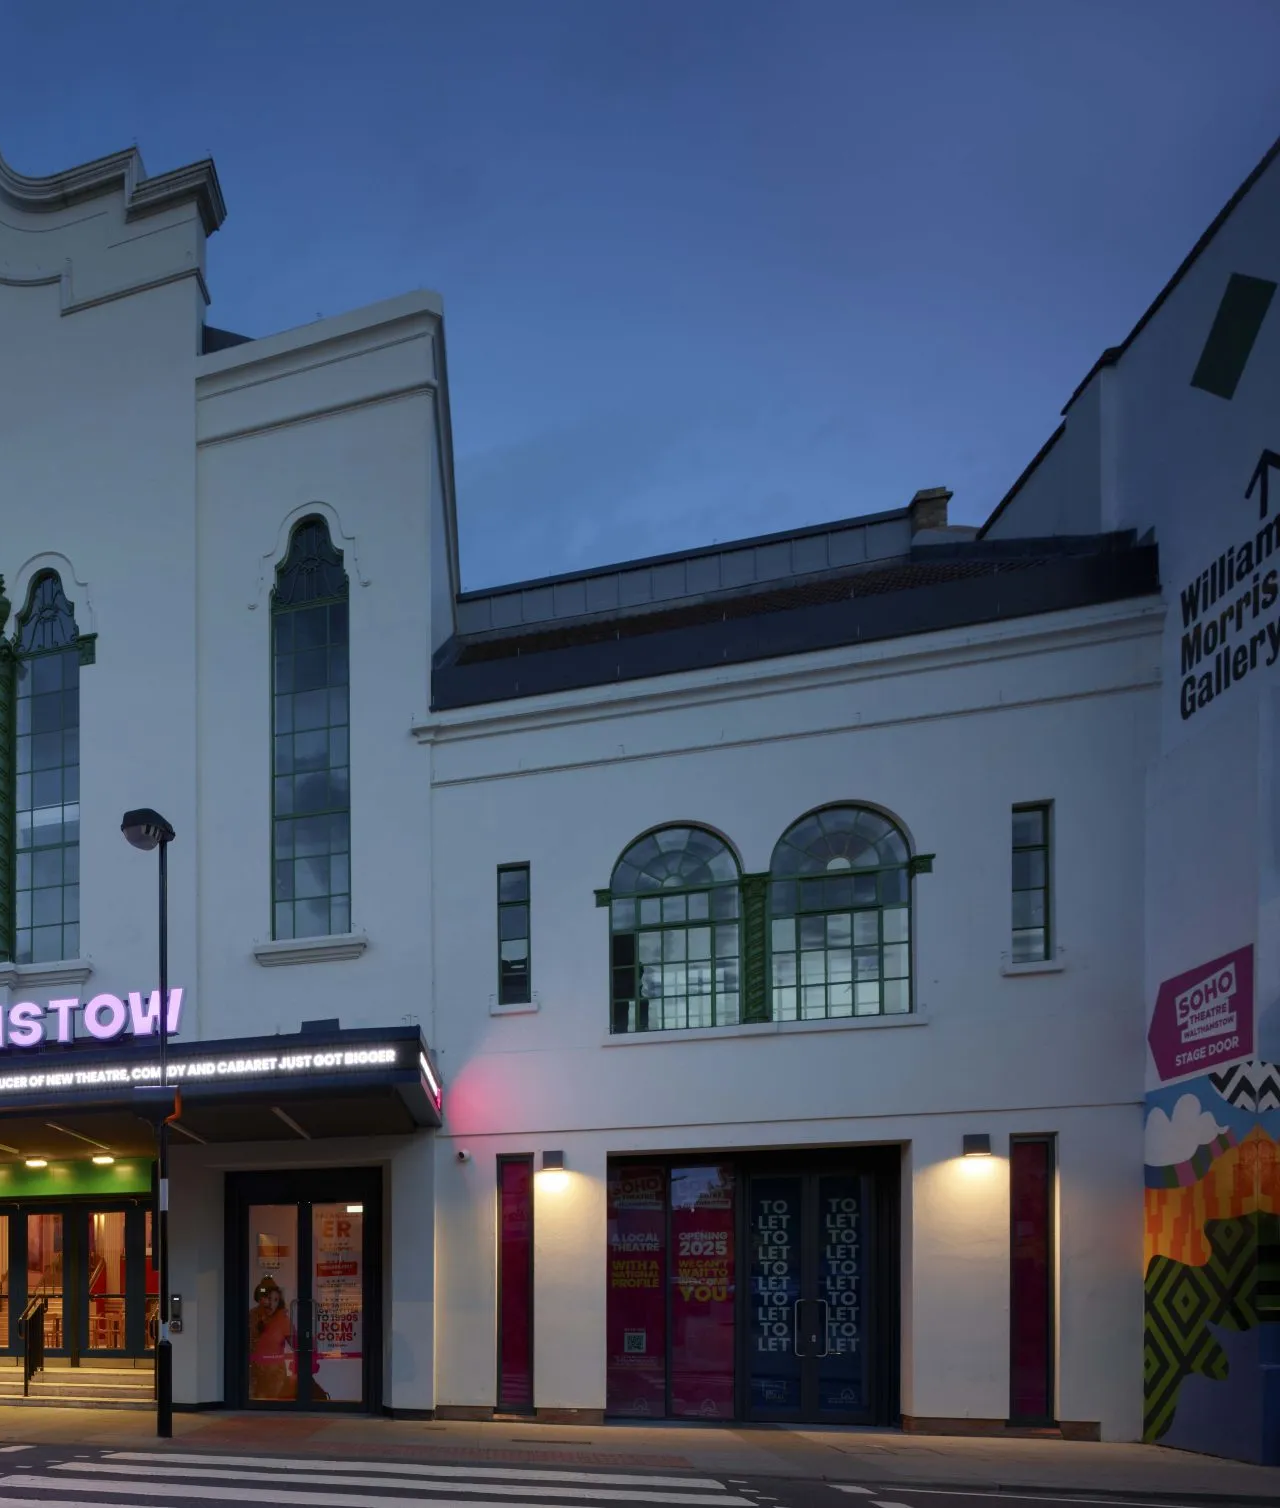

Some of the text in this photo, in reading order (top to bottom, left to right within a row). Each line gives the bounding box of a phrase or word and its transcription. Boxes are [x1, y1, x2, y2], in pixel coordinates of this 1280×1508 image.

[1180, 512, 1280, 628] William
[1181, 569, 1278, 676] Morris
[1180, 617, 1280, 720] Gallery
[1179, 971, 1233, 1018] SOHO
[1189, 1002, 1228, 1024] THEATRE
[1183, 1015, 1234, 1039] WALTHAMSTOW
[1175, 1035, 1239, 1066] STAGE DOOR
[29, 1075, 45, 1087] OF
[47, 1073, 74, 1085] NEW
[75, 1069, 130, 1083] THEATRE,
[132, 1065, 186, 1079] COMDY
[187, 1062, 216, 1076] AND
[217, 1058, 277, 1074] CABARET
[279, 1055, 313, 1069] JUST
[314, 1053, 343, 1066] GOT
[344, 1049, 396, 1064] BIGGER
[759, 1200, 788, 1214] TO
[828, 1198, 857, 1213] TO
[758, 1215, 791, 1230] LET
[826, 1213, 860, 1228] LET
[623, 1233, 659, 1242] LOCAL
[678, 1231, 728, 1240] OPENING
[759, 1230, 788, 1245] TO
[828, 1229, 857, 1244] TO
[612, 1243, 660, 1252] THEATRE
[678, 1241, 728, 1256] 2025
[758, 1246, 791, 1260] LET
[826, 1244, 860, 1259] LET
[612, 1260, 659, 1271] WITH A
[759, 1261, 788, 1275] TO
[828, 1260, 857, 1275] TO
[679, 1269, 728, 1278] WAIT TO
[612, 1279, 660, 1288] PROFILE
[758, 1276, 791, 1290] LET
[826, 1276, 860, 1290] LET
[680, 1286, 727, 1302] YOU
[759, 1291, 788, 1306] TO
[828, 1291, 857, 1306] TO
[758, 1307, 791, 1321] LET
[321, 1322, 353, 1333] ROM
[759, 1322, 788, 1337] TO
[828, 1322, 857, 1336] TO
[758, 1338, 791, 1352] LET
